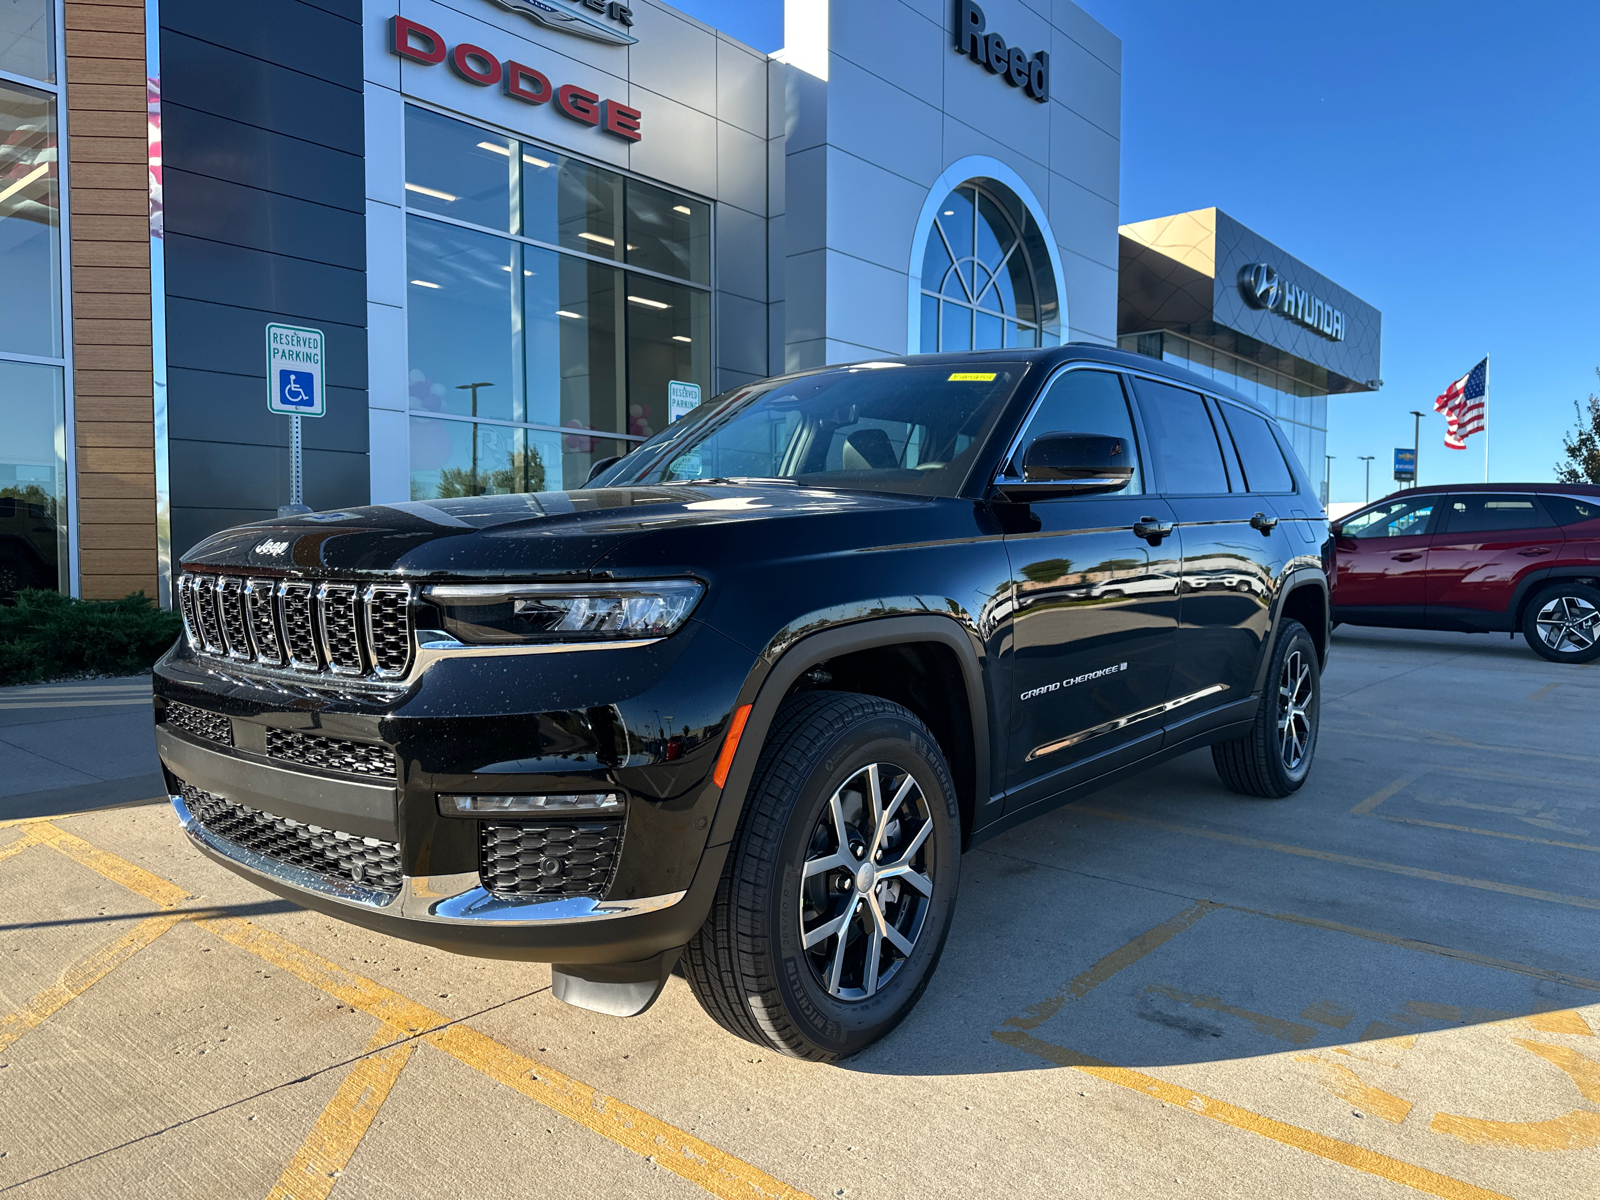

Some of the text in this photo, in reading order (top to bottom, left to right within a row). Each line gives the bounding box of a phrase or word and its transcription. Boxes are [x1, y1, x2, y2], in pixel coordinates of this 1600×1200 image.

[955, 0, 1050, 104] Reed
[389, 14, 642, 144] DODGE
[1284, 280, 1345, 341] HYUNDAI
[272, 332, 319, 350] RESERVED
[272, 347, 320, 365] PARKING
[672, 387, 698, 400] RESERVED
[255, 538, 290, 557] Jeep
[1020, 682, 1061, 701] GRAND
[1062, 664, 1119, 688] CHEROKEE
[926, 751, 957, 817] MICHELIN
[785, 959, 827, 1031] MICHELIN
